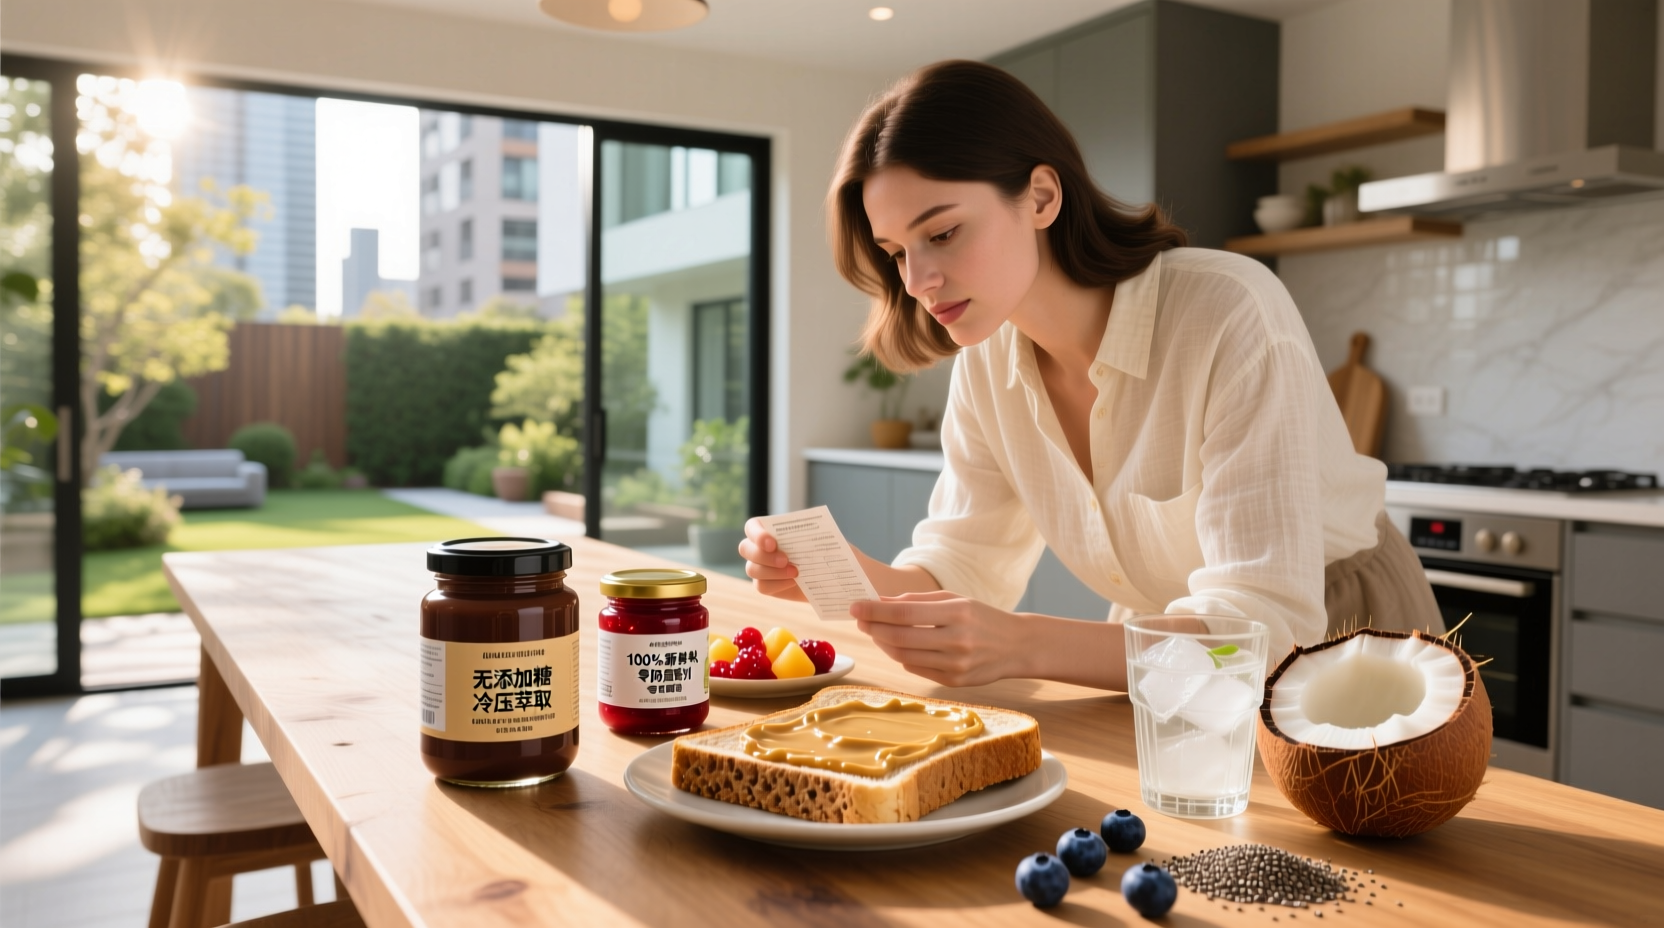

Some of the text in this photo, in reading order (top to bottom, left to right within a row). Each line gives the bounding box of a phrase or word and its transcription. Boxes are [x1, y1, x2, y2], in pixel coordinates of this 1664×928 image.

[472, 665, 553, 690] 无添加糖
[472, 690, 552, 713] 冷压萃取
